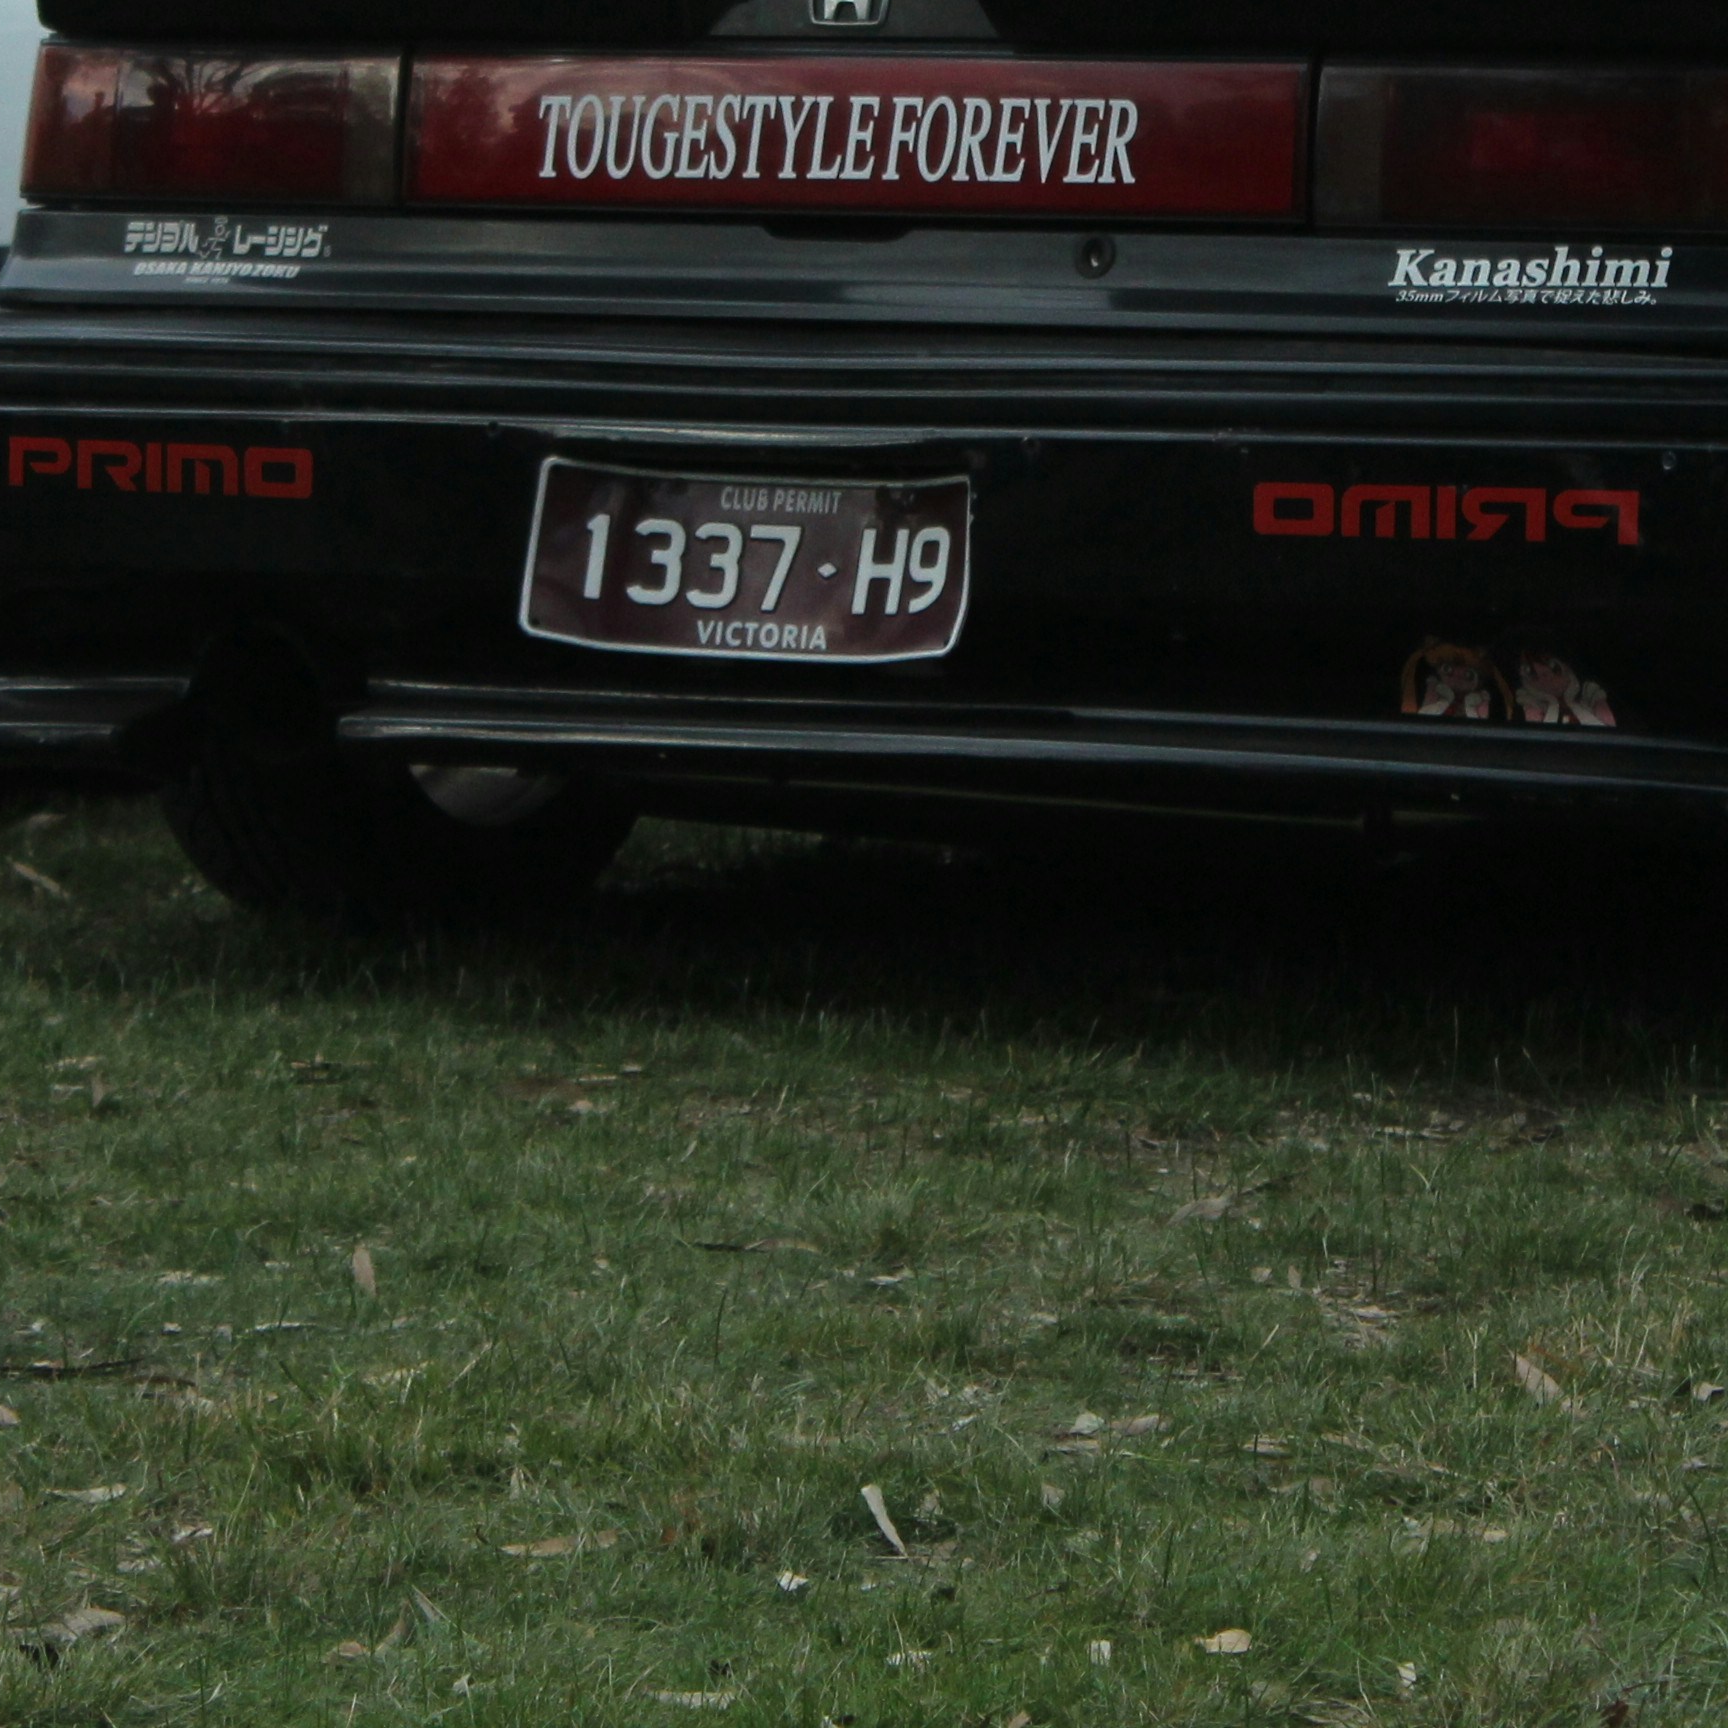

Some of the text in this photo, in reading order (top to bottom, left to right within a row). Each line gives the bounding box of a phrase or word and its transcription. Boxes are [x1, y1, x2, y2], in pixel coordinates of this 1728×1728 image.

[880, 94, 1140, 186] FOREVER
[132, 260, 188, 276] OSAKA
[1387, 244, 1673, 288] Kanashimi
[8, 435, 314, 500] PRIMO
[719, 485, 842, 515] CLUB PERMIT
[581, 512, 952, 615] 1337 H9
[695, 619, 828, 651] VICTORIA
